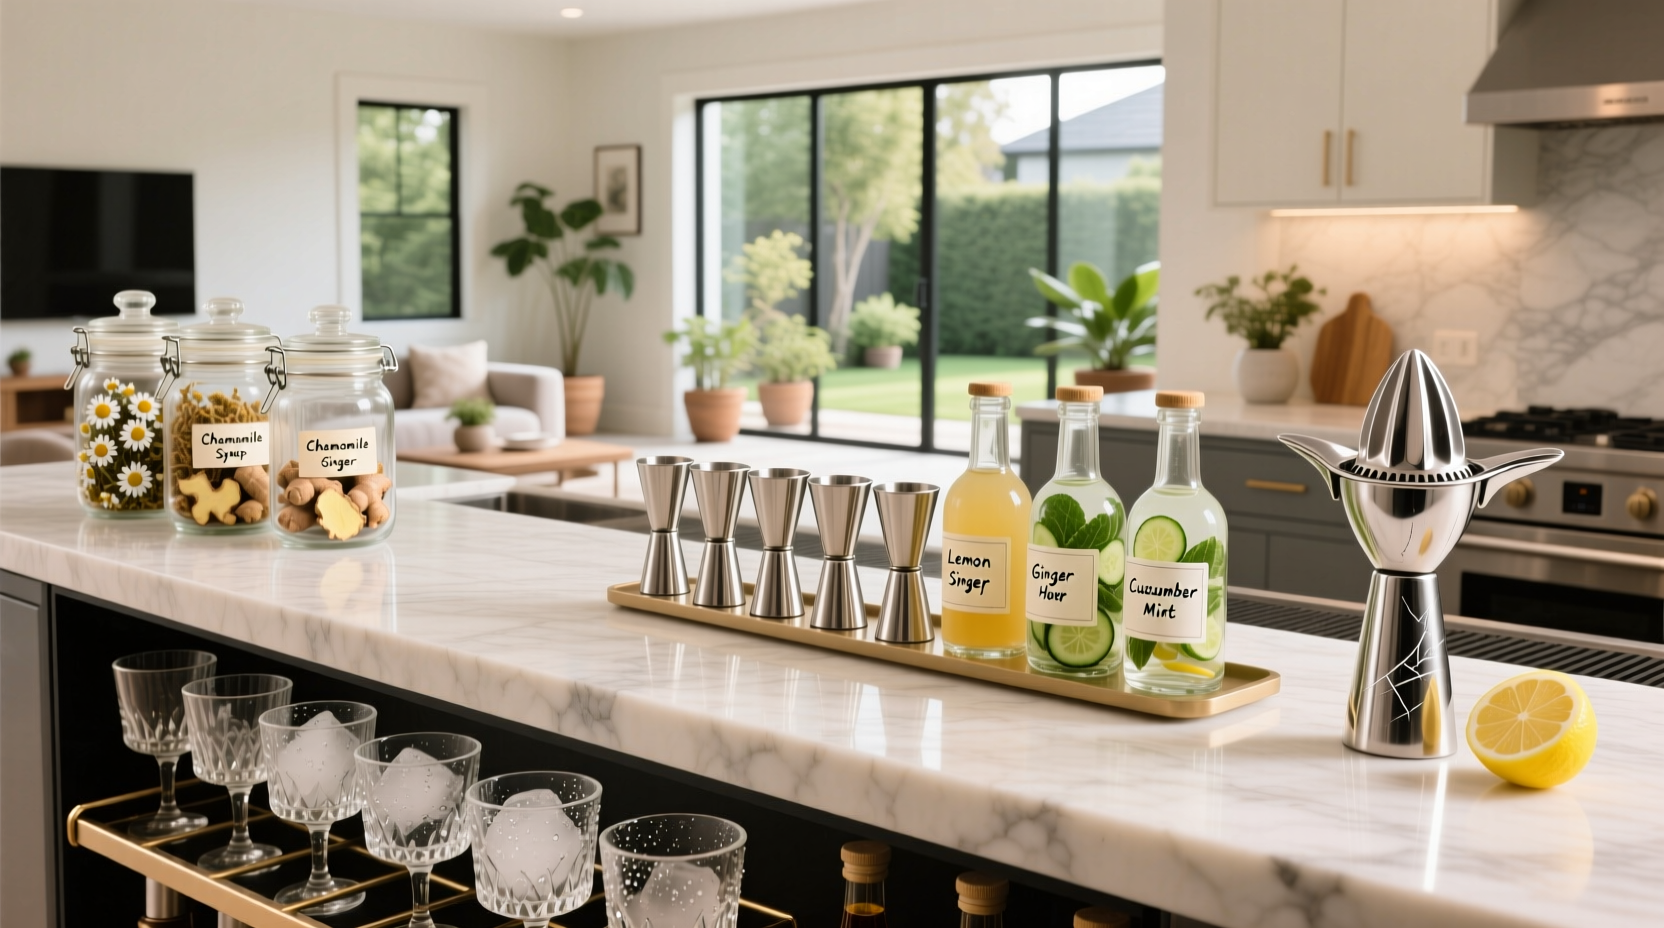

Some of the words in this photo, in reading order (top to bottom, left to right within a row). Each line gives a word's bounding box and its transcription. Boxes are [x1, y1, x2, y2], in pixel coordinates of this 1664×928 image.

[306, 436, 369, 452] Chamomile
[948, 548, 991, 569] Lemon
[1031, 563, 1075, 587] Ginger
